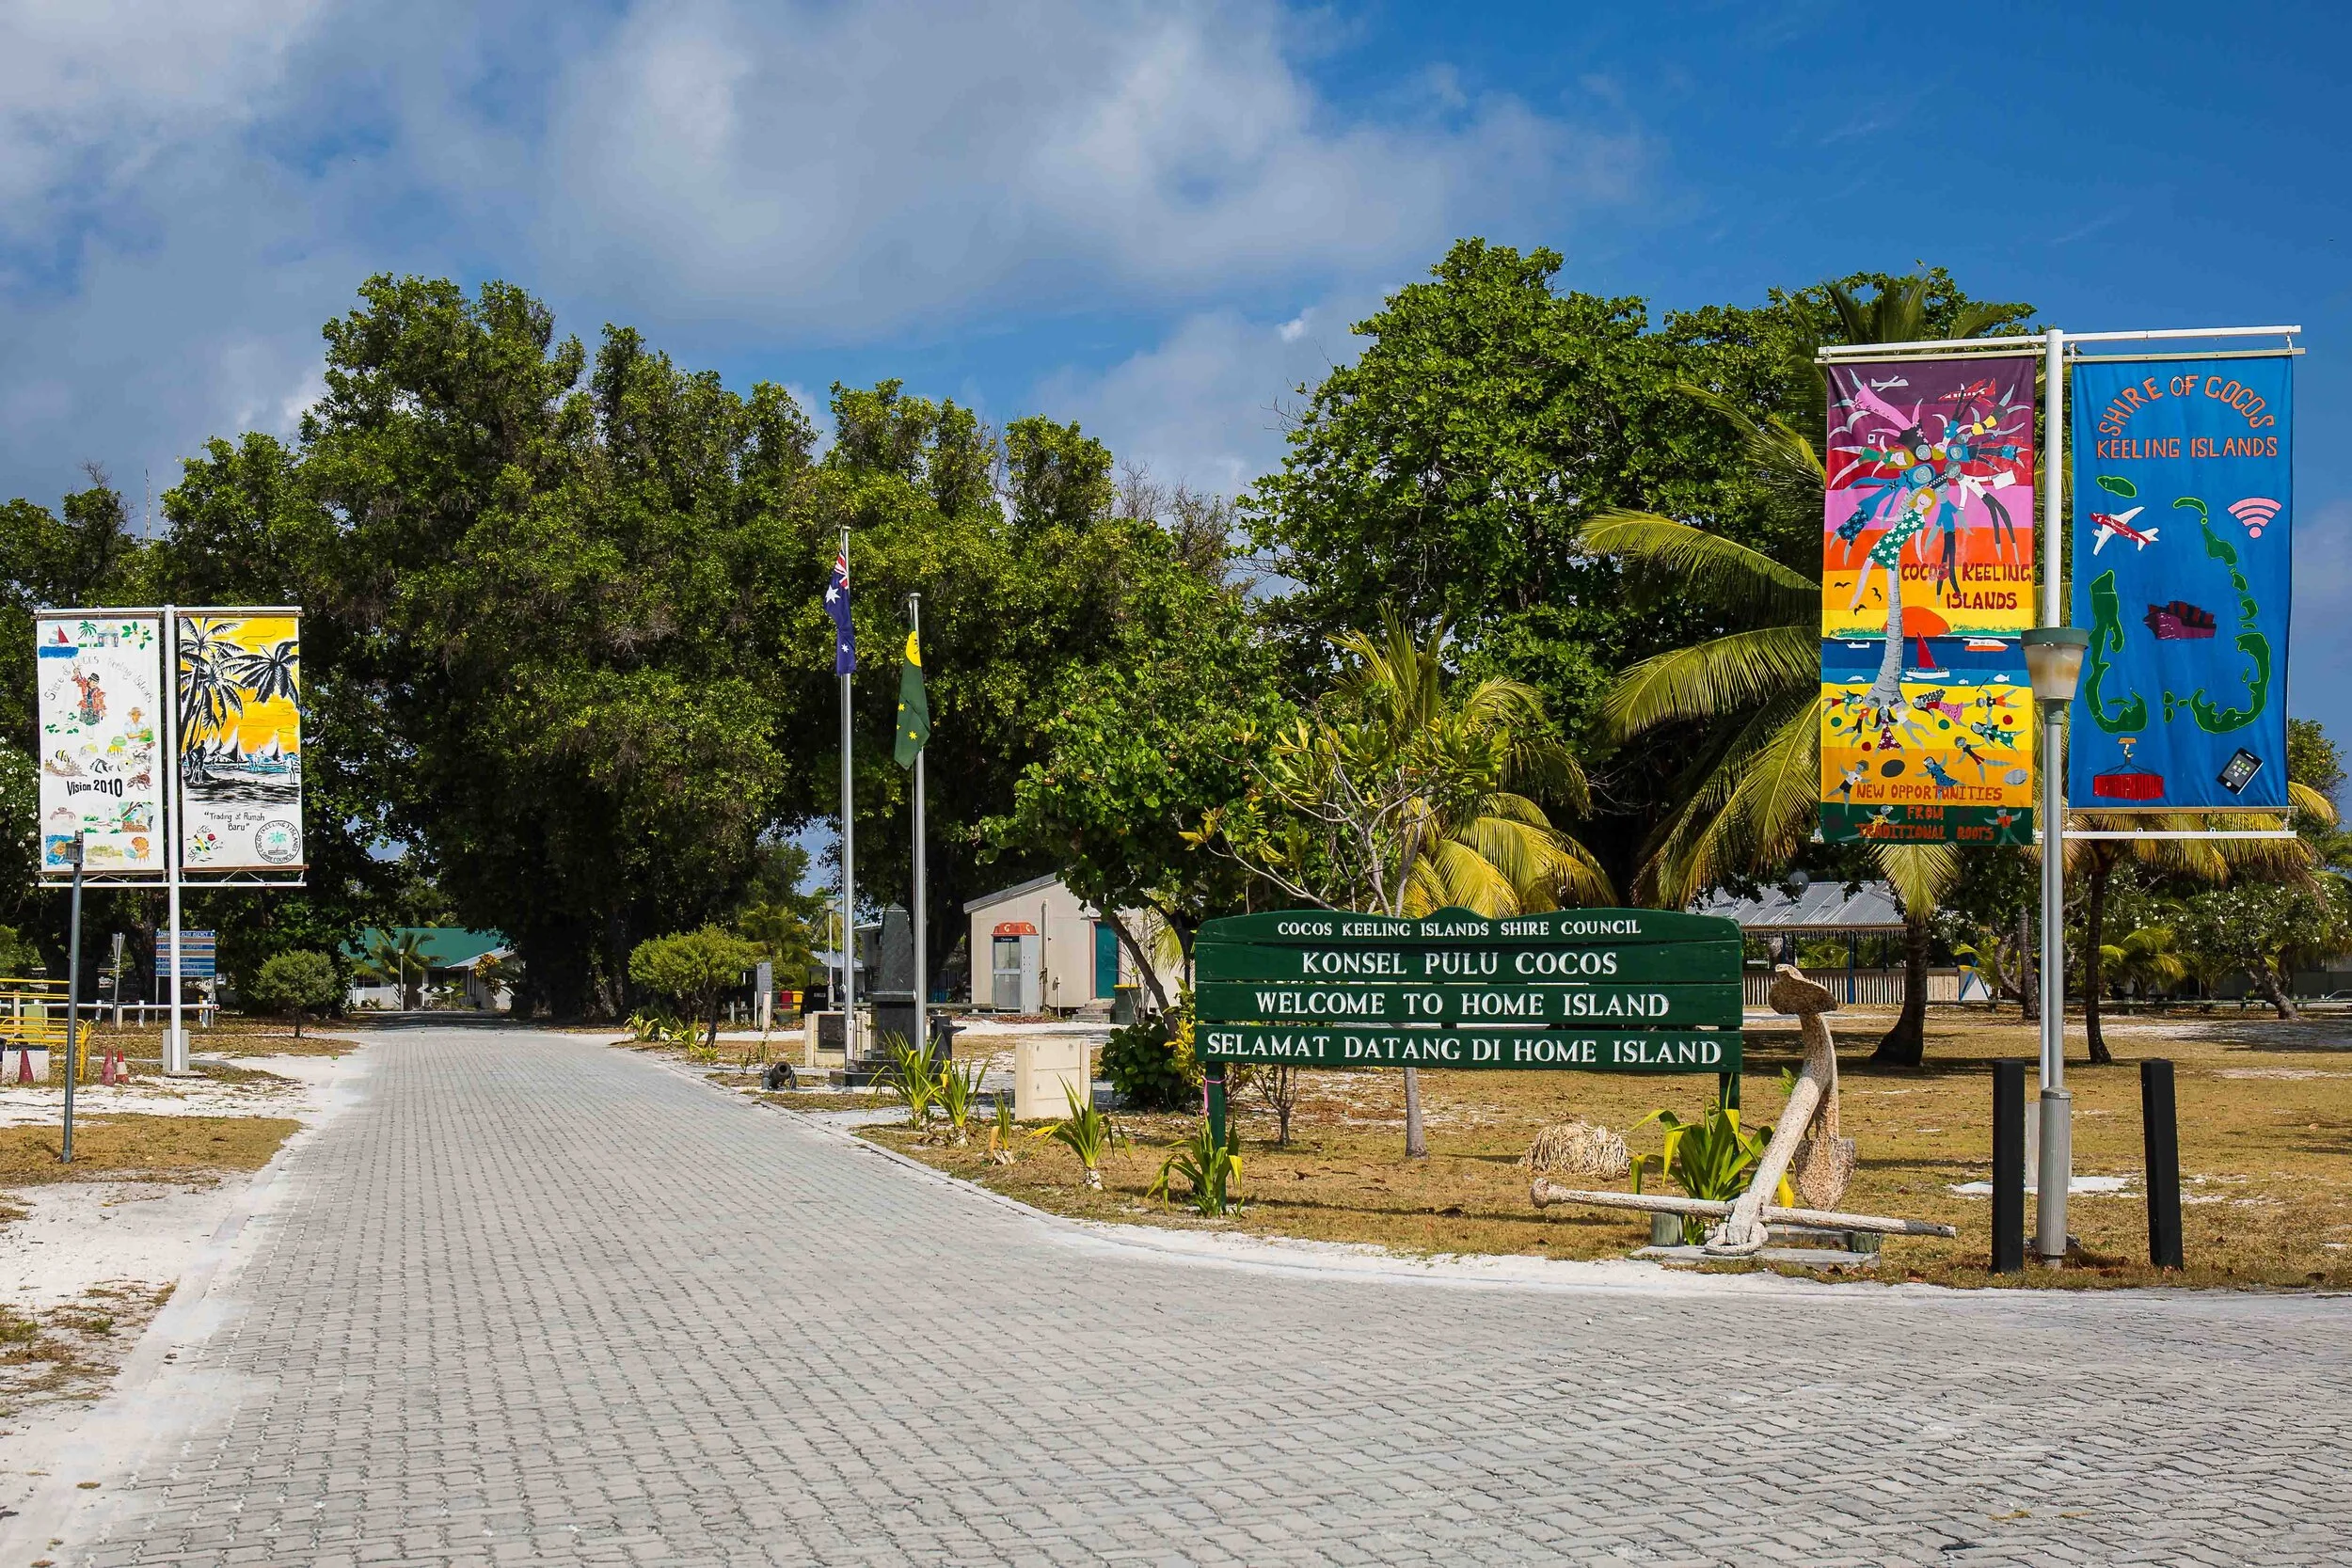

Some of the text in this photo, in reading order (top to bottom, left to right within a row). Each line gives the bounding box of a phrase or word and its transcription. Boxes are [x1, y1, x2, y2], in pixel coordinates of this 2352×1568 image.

[2098, 374, 2275, 436] SHIRE OF COCOS
[2096, 436, 2278, 459] KEELING ISLANDS
[1900, 562, 2032, 582] COCOS KEELING
[1947, 592, 2018, 610] ISLANDS
[66, 778, 123, 798] Vision 2010
[1856, 784, 2003, 801] NEW OPPORTUNITIES
[1907, 805, 1945, 820] FROM
[1855, 823, 1995, 841] TRADITIONAL ROOTS
[1277, 920, 1642, 937] COCOS KEELING ISLANDS SHIRE COUNCIL
[1302, 952, 1617, 975] KONSEL PULU COCOS
[1255, 991, 1670, 1017] WELCOME TO HOME ISLAND
[1207, 1033, 1722, 1064] SELAMAT DATANG DI HOME ISLAND
